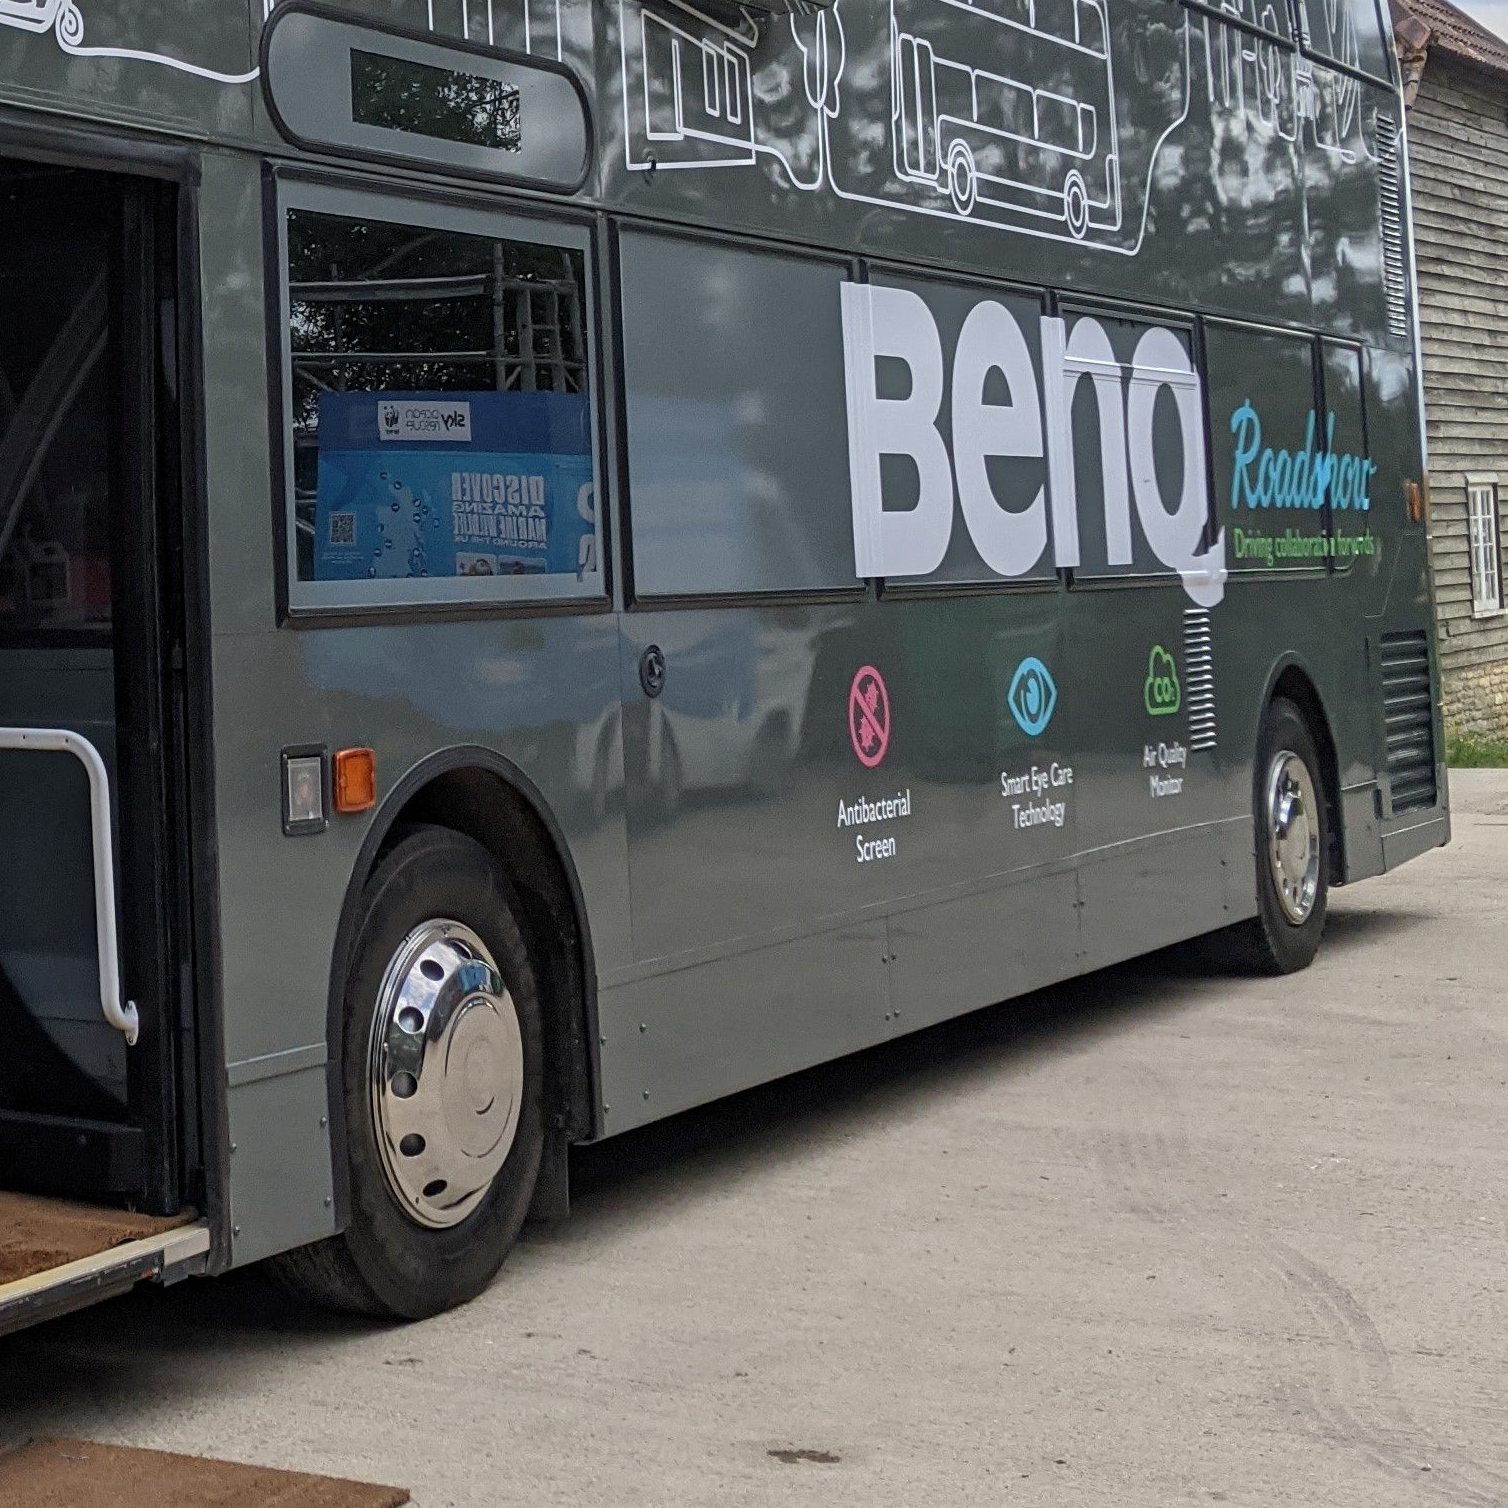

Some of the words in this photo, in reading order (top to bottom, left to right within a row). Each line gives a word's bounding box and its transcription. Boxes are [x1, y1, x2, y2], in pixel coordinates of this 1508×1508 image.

[840, 281, 1228, 607] BenQ
[1001, 771, 1031, 797] Smart
[1031, 766, 1049, 797] Eye
[1050, 762, 1074, 787] Care
[837, 789, 911, 827] Antibacterial
[1012, 798, 1066, 829] Technology
[856, 835, 896, 863] Screen
